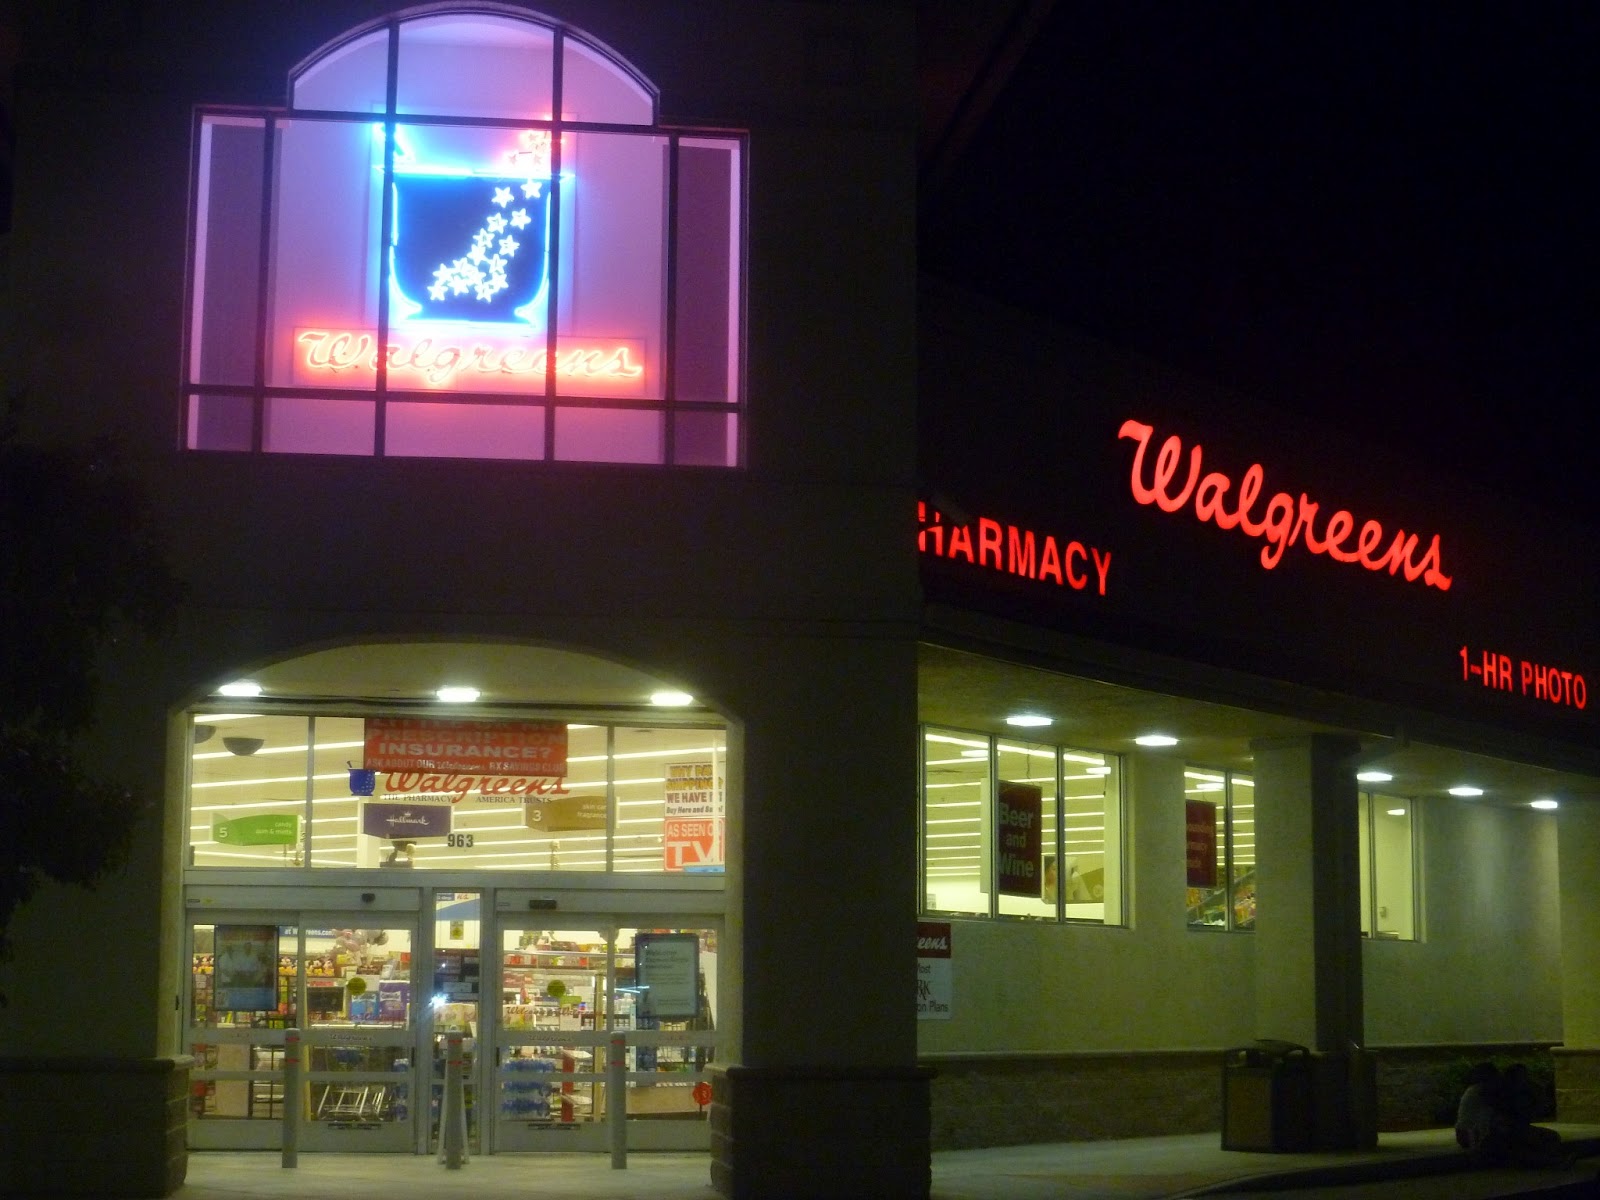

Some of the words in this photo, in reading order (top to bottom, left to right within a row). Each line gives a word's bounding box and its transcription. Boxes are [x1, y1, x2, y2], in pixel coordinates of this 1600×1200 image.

[297, 330, 644, 386] Walgreens
[1118, 420, 1452, 591] Walgreens
[1460, 646, 1513, 692] 1-HR
[1521, 661, 1587, 710] PHOTO
[379, 742, 552, 759] INSURANCE?
[416, 759, 435, 769] OUR
[385, 771, 570, 804] Walgreens
[475, 796, 516, 804] AMERICA
[667, 792, 681, 804] WE
[682, 791, 707, 803] HAVE
[386, 814, 430, 828] Hallmark
[532, 809, 542, 822] 3
[999, 802, 1034, 829] Beer
[219, 827, 228, 838] 5
[667, 824, 679, 837] AS
[681, 823, 706, 837] SEEN
[447, 833, 474, 847] 963
[1006, 833, 1026, 848] and
[667, 841, 722, 867] TV
